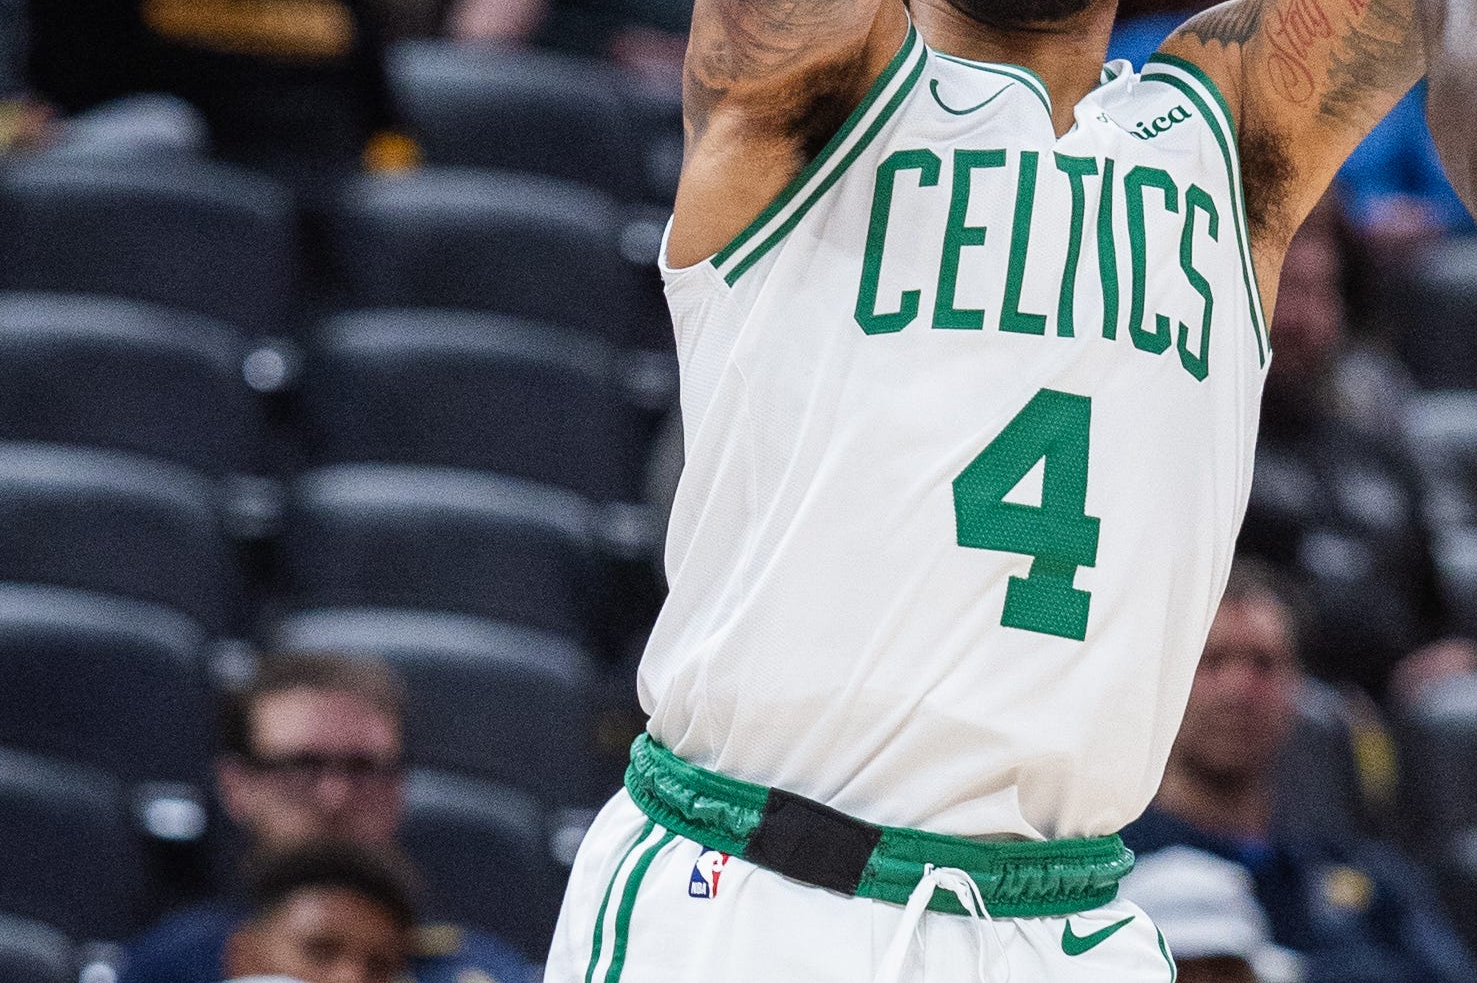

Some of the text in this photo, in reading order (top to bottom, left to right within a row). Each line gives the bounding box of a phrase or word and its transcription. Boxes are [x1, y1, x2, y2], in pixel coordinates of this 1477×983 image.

[854, 148, 1220, 382] CELTICS
[952, 387, 1101, 642] 4
[690, 881, 707, 895] NBA
